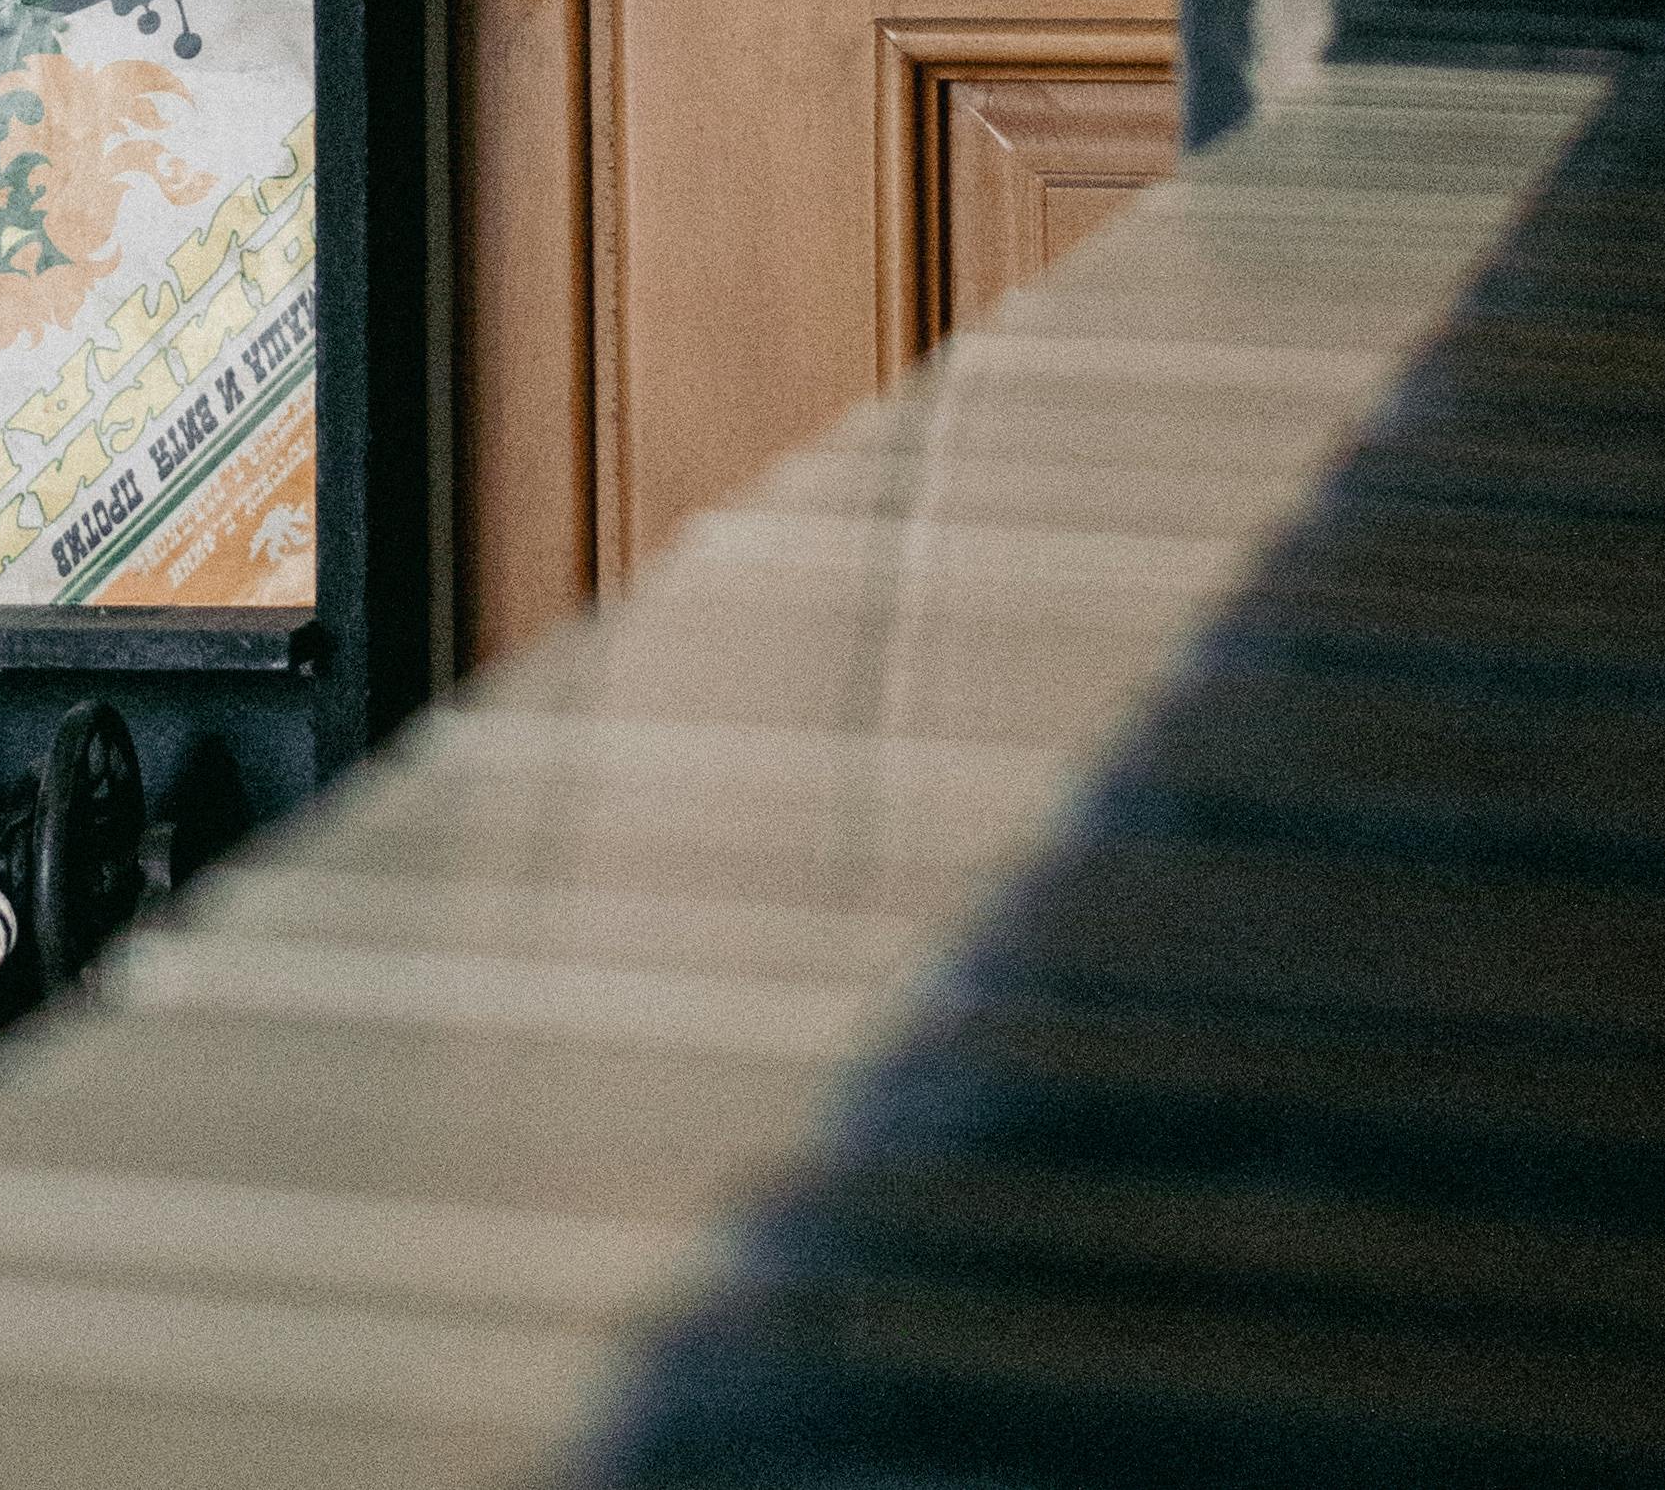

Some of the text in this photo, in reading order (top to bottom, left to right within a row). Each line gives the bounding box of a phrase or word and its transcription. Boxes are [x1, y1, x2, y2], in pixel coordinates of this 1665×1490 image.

[215, 366, 248, 417] И
[147, 393, 222, 484] ВИТЯ
[50, 467, 145, 579] ПРОТИВ
